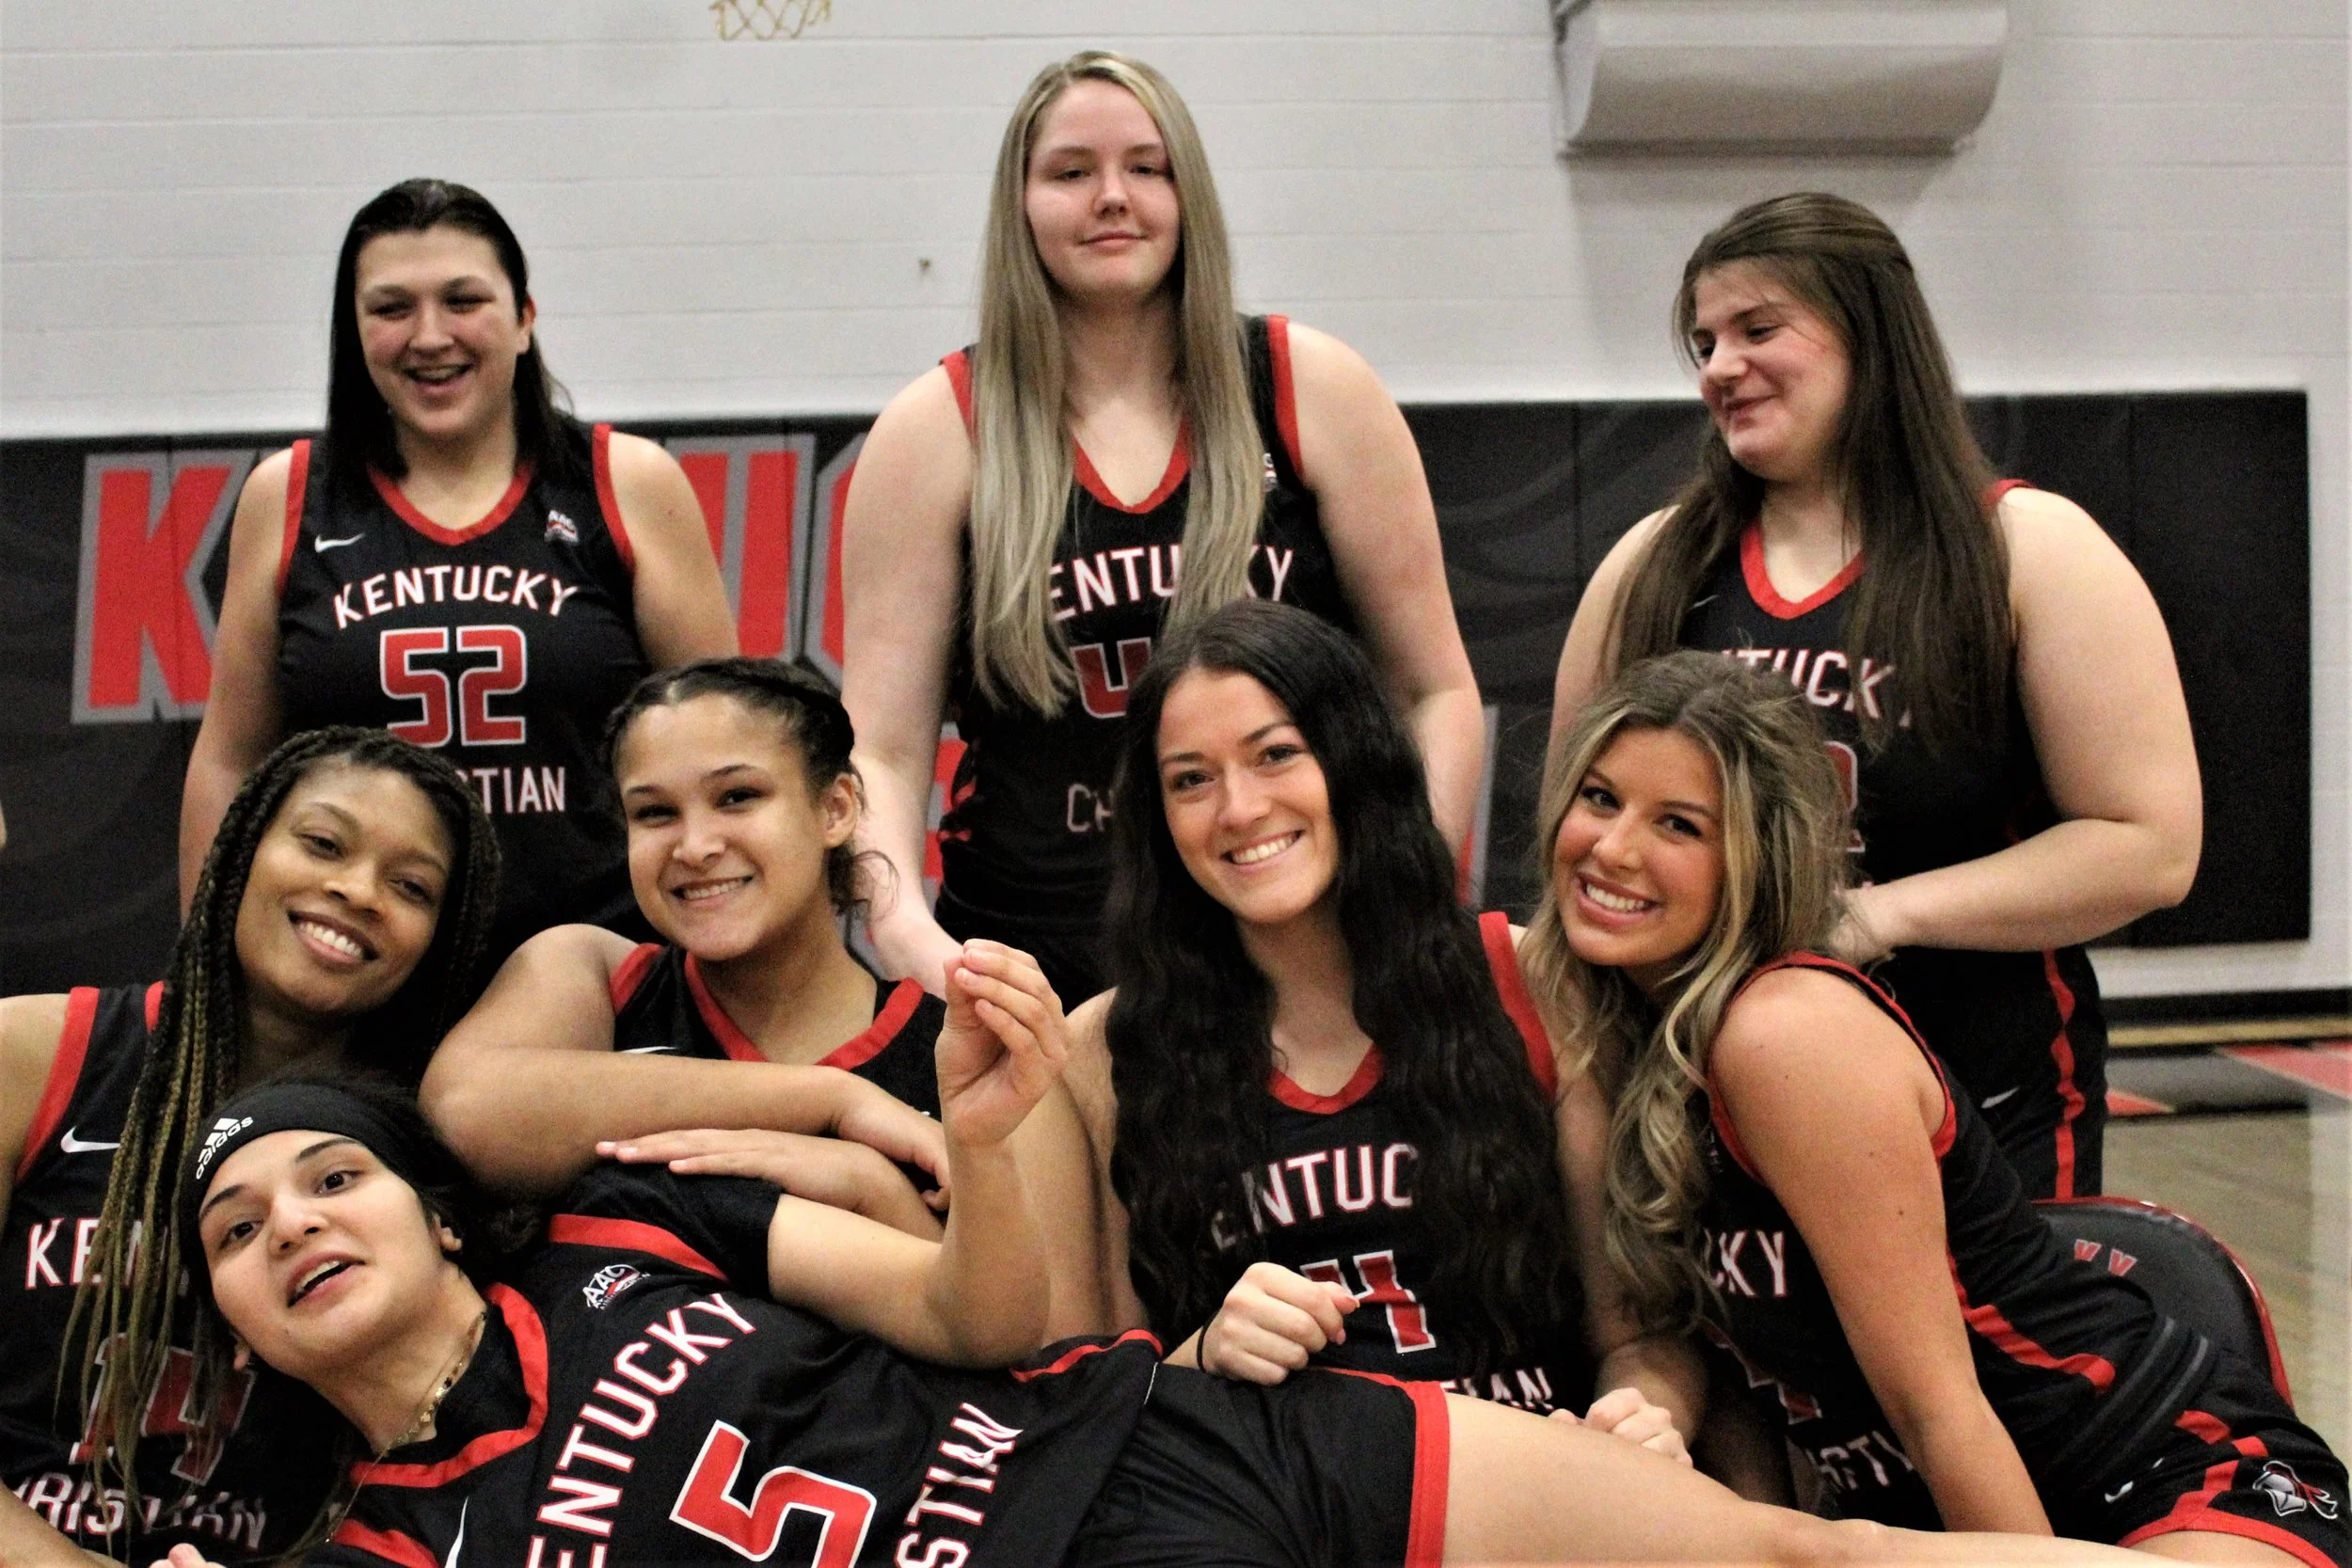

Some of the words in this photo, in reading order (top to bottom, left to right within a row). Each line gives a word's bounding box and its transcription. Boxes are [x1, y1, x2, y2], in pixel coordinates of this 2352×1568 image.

[333, 564, 579, 630] KENTUCKY
[379, 624, 527, 749] 52
[455, 766, 566, 815] TIAN
[196, 1117, 254, 1180] adidas
[669, 1418, 878, 1568] 5
